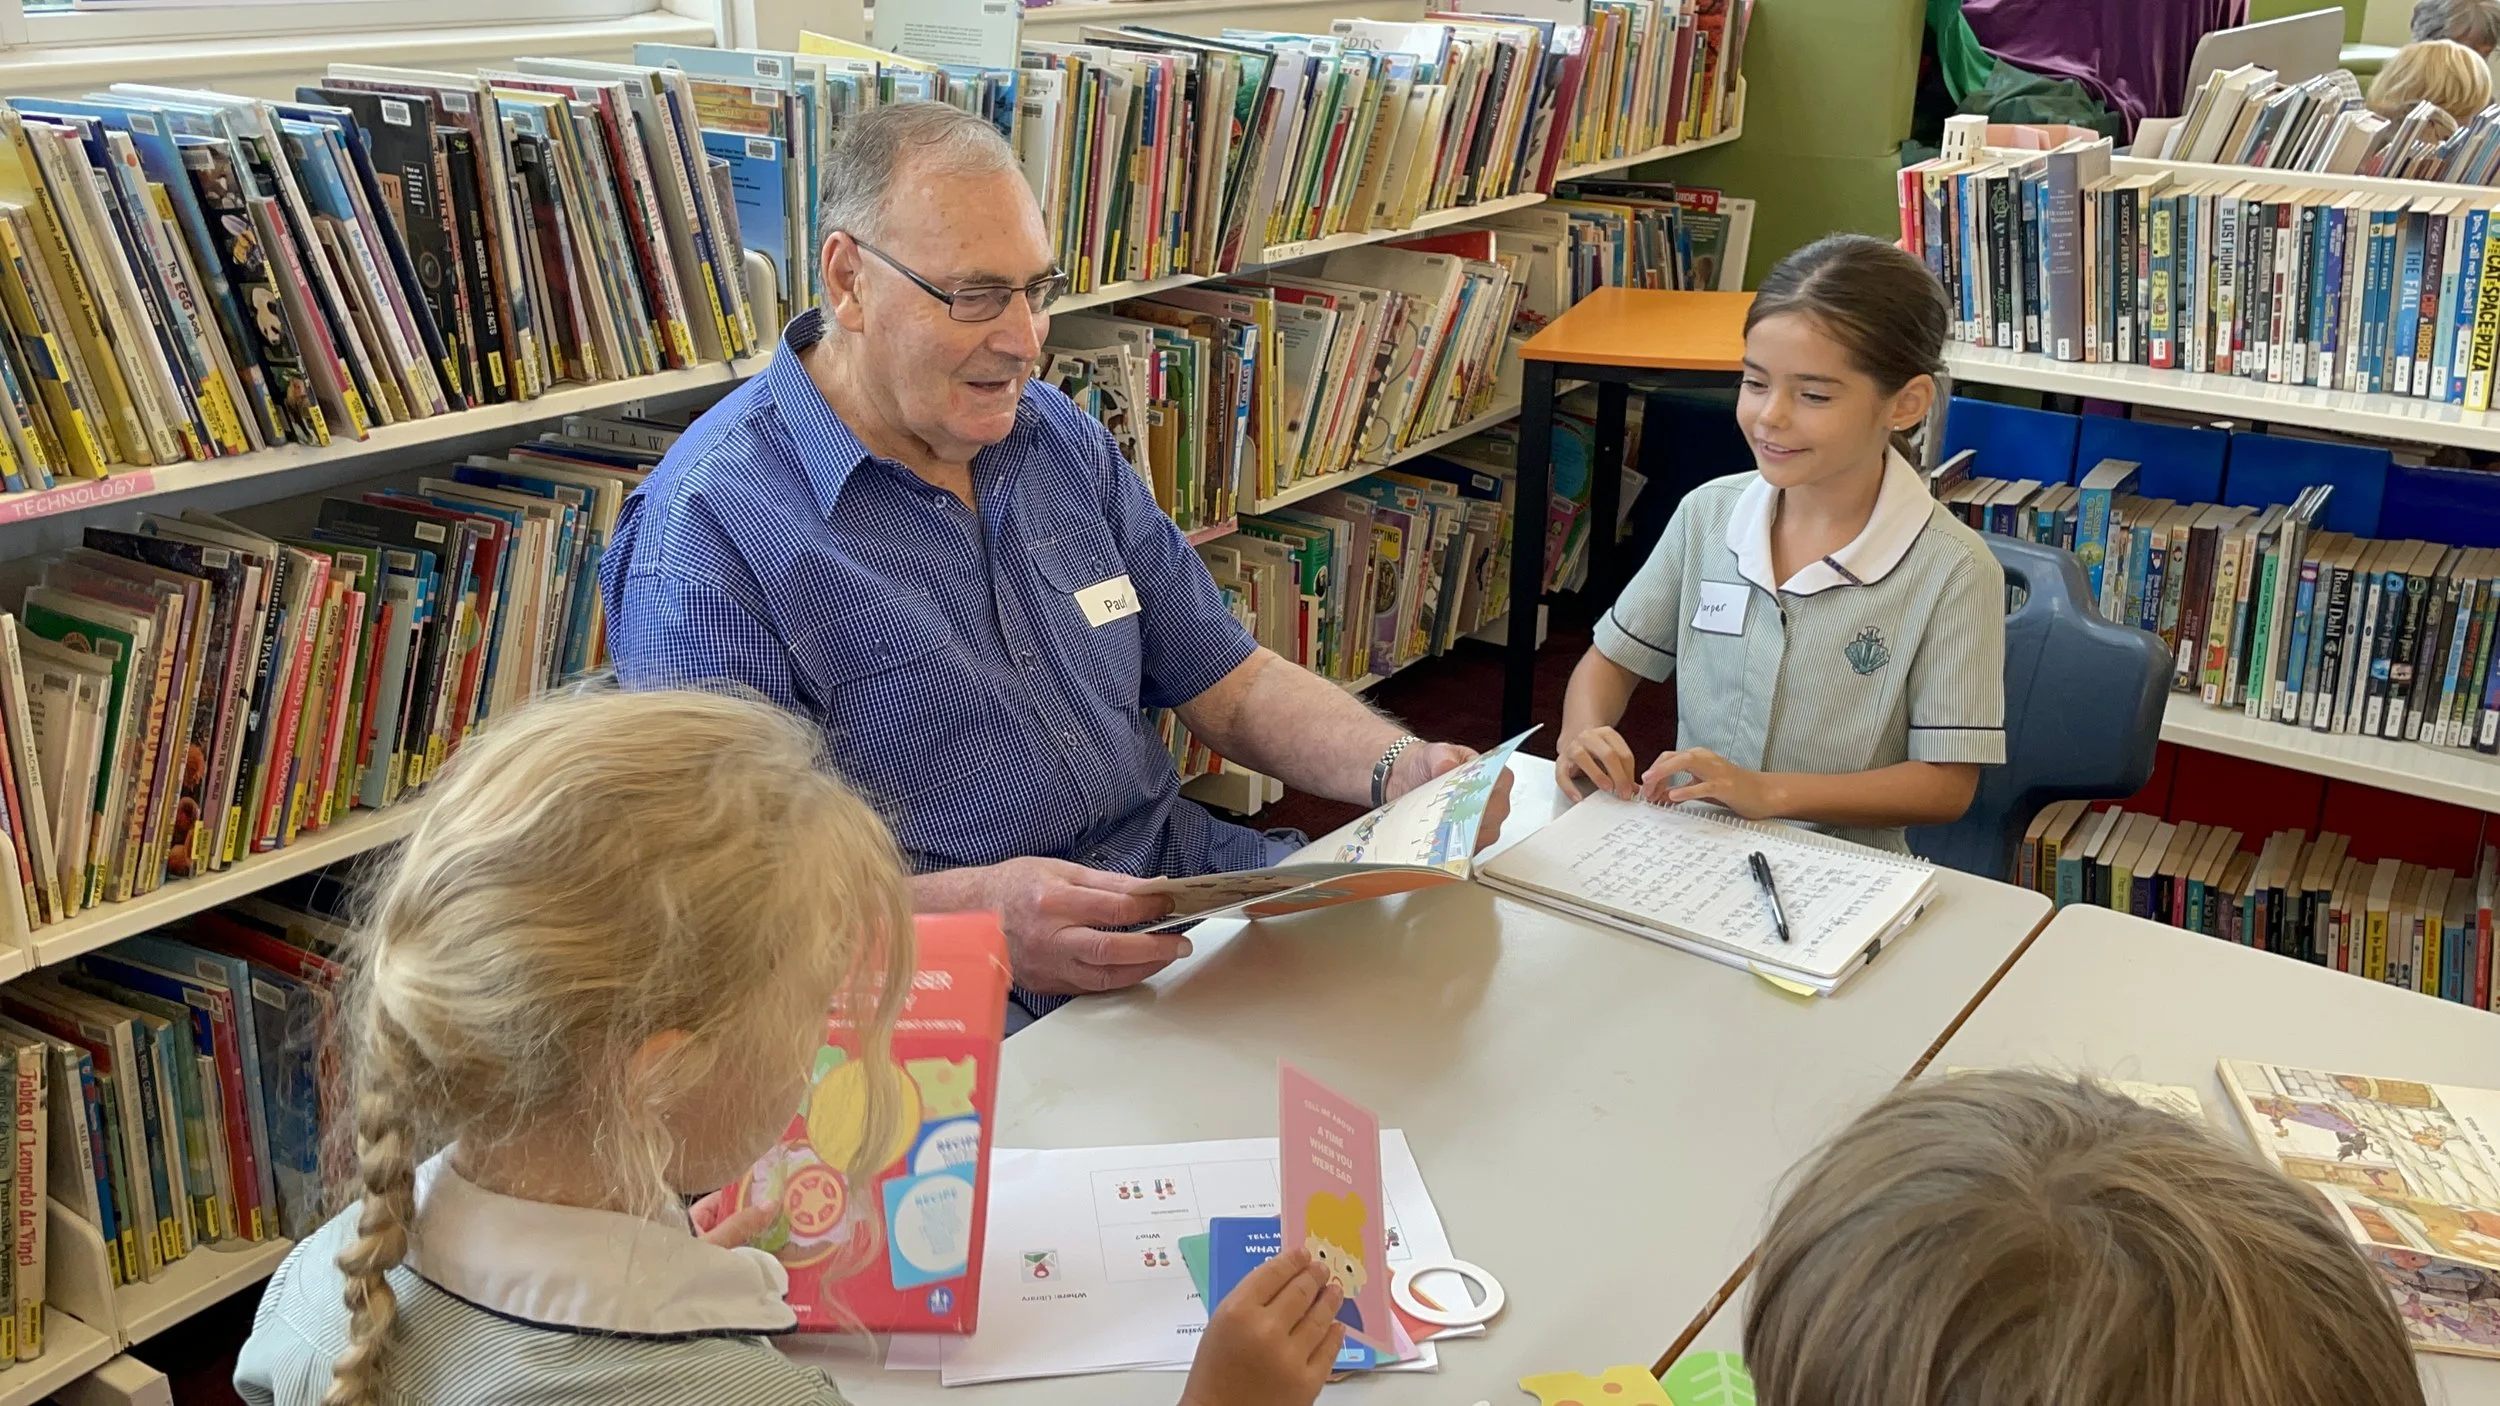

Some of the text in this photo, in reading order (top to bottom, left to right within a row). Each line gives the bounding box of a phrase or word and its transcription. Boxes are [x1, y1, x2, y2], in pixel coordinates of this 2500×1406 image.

[542, 148, 559, 185] THE SUN
[656, 97, 696, 215] WILD AUSTRALIAN LIFE
[1675, 192, 1714, 204] UIDE TO
[2222, 207, 2236, 216] THE
[2120, 206, 2129, 234] SECRET
[2467, 213, 2483, 241] Don't
[33, 185, 100, 338] Dinosaurs and Prehistoric Animals
[1998, 248, 2006, 266] DARK
[2219, 217, 2234, 286] LAST HUMAN
[2465, 241, 2480, 259] call
[2401, 249, 2421, 312] THE FALL
[2466, 261, 2476, 275] me
[2483, 253, 2500, 282] CAT
[165, 260, 204, 339] The EGG Book
[472, 239, 498, 335] INCREDIBLE FACTS
[2120, 275, 2128, 300] POINT
[2420, 293, 2436, 317] COP
[2476, 285, 2499, 329] SPACE
[2415, 323, 2432, 359] ROBBE
[2470, 333, 2494, 374] PIZZA
[12, 478, 136, 517] TECHNOLOGY
[1103, 593, 1128, 613] Paul
[2331, 570, 2348, 604] Roald
[324, 604, 340, 636] GASKIN
[2326, 608, 2343, 637] Dahl
[234, 624, 253, 672] CHRISTMAS
[255, 634, 275, 678] SPACE
[292, 642, 313, 705] CHILDREN'S
[315, 660, 329, 688] HEART
[226, 673, 243, 712] COOKING
[130, 647, 172, 841] ALL ABOUT PEOPL
[219, 715, 234, 751] AROUND
[284, 709, 300, 748] WORLD
[24, 745, 40, 787] MACHINE
[216, 752, 226, 767] THE
[209, 769, 224, 800] WORLD
[273, 749, 292, 805] COOKBOO
[1304, 1100, 1320, 1112] TELL
[1332, 1113, 1355, 1135] ABOUT
[77, 1123, 92, 1170] SAIL AWAY
[1309, 1136, 1353, 1169] WHEN YOU
[1317, 1126, 1344, 1149] A TIME
[14, 1068, 38, 1266] Fables of Leonardo da Vinci
[1311, 1153, 1353, 1185] WERE SAD
[1135, 1232, 1160, 1240] Who?
[1245, 1245, 1281, 1254] WHAT
[1247, 1232, 1271, 1240] TELL
[1021, 1291, 1088, 1303] Where: Library
[1176, 1326, 1207, 1335] ysius
